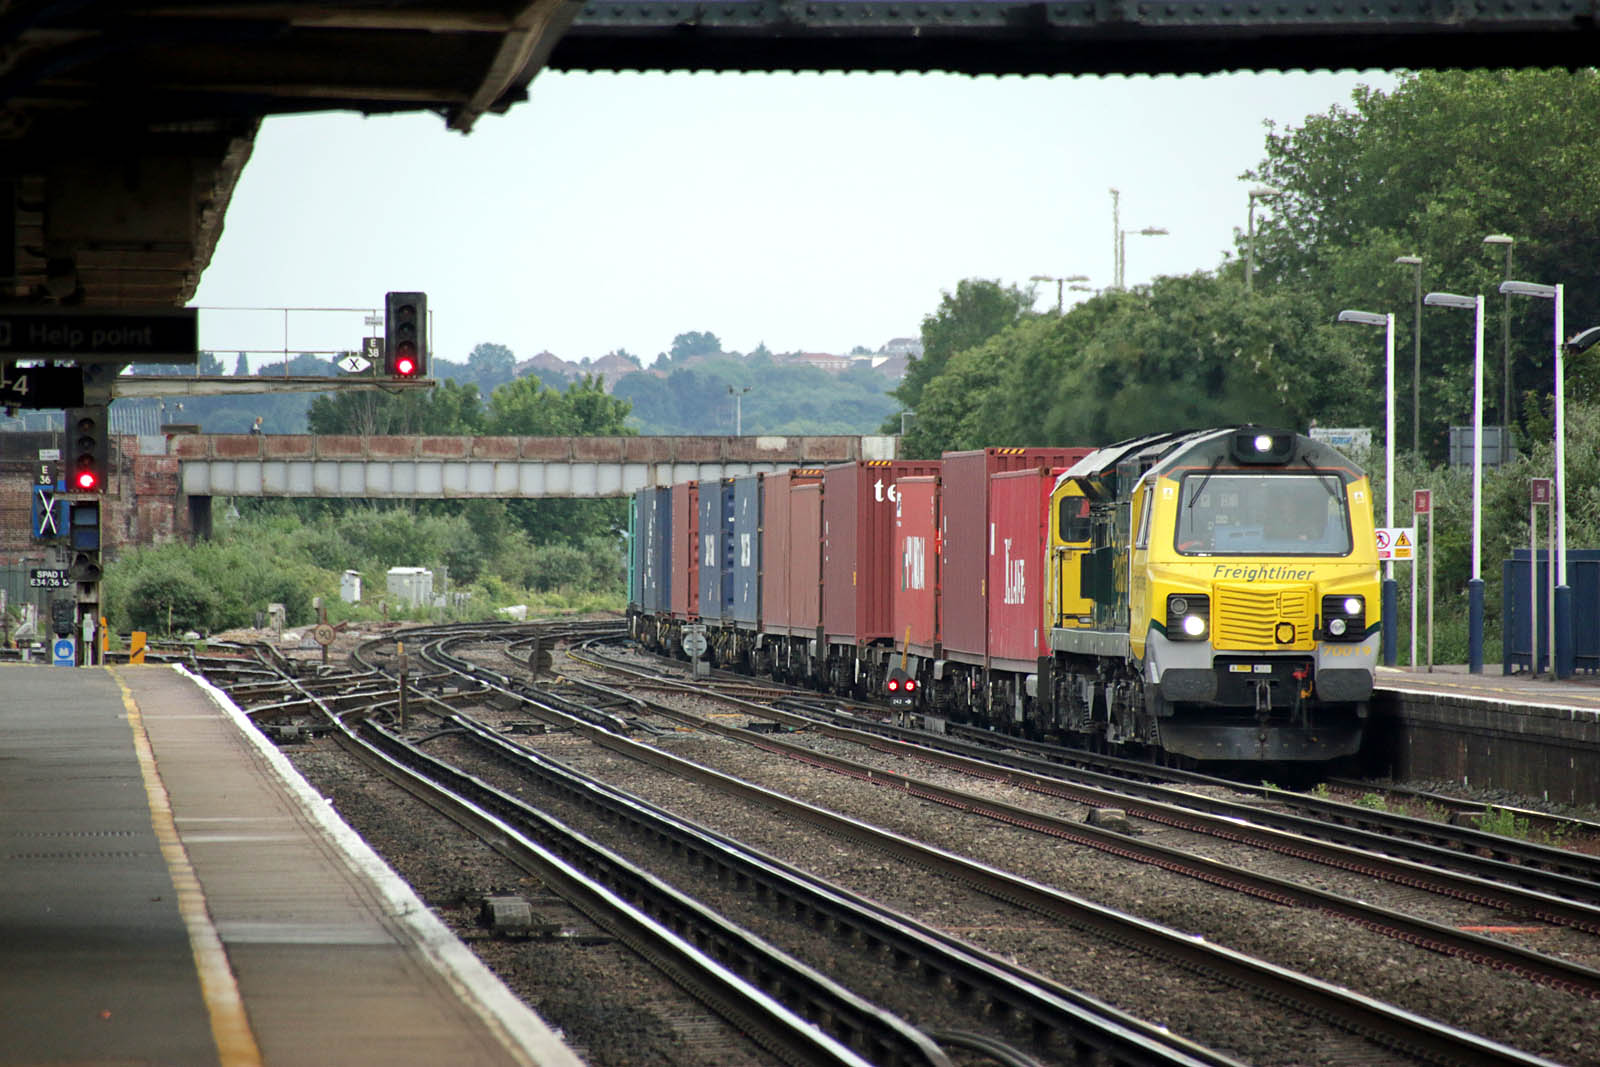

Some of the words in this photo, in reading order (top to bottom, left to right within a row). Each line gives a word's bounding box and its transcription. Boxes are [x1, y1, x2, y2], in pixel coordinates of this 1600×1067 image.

[29, 323, 83, 346] Help
[92, 325, 152, 347] point
[370, 339, 376, 347] E
[368, 348, 379, 357] 38
[42, 466, 48, 474] E
[40, 475, 51, 484] 36
[36, 570, 59, 579] SPAD
[1213, 565, 1316, 582] Freightliner
[30, 578, 60, 587] E34/36
[1323, 645, 1372, 657] 70019
